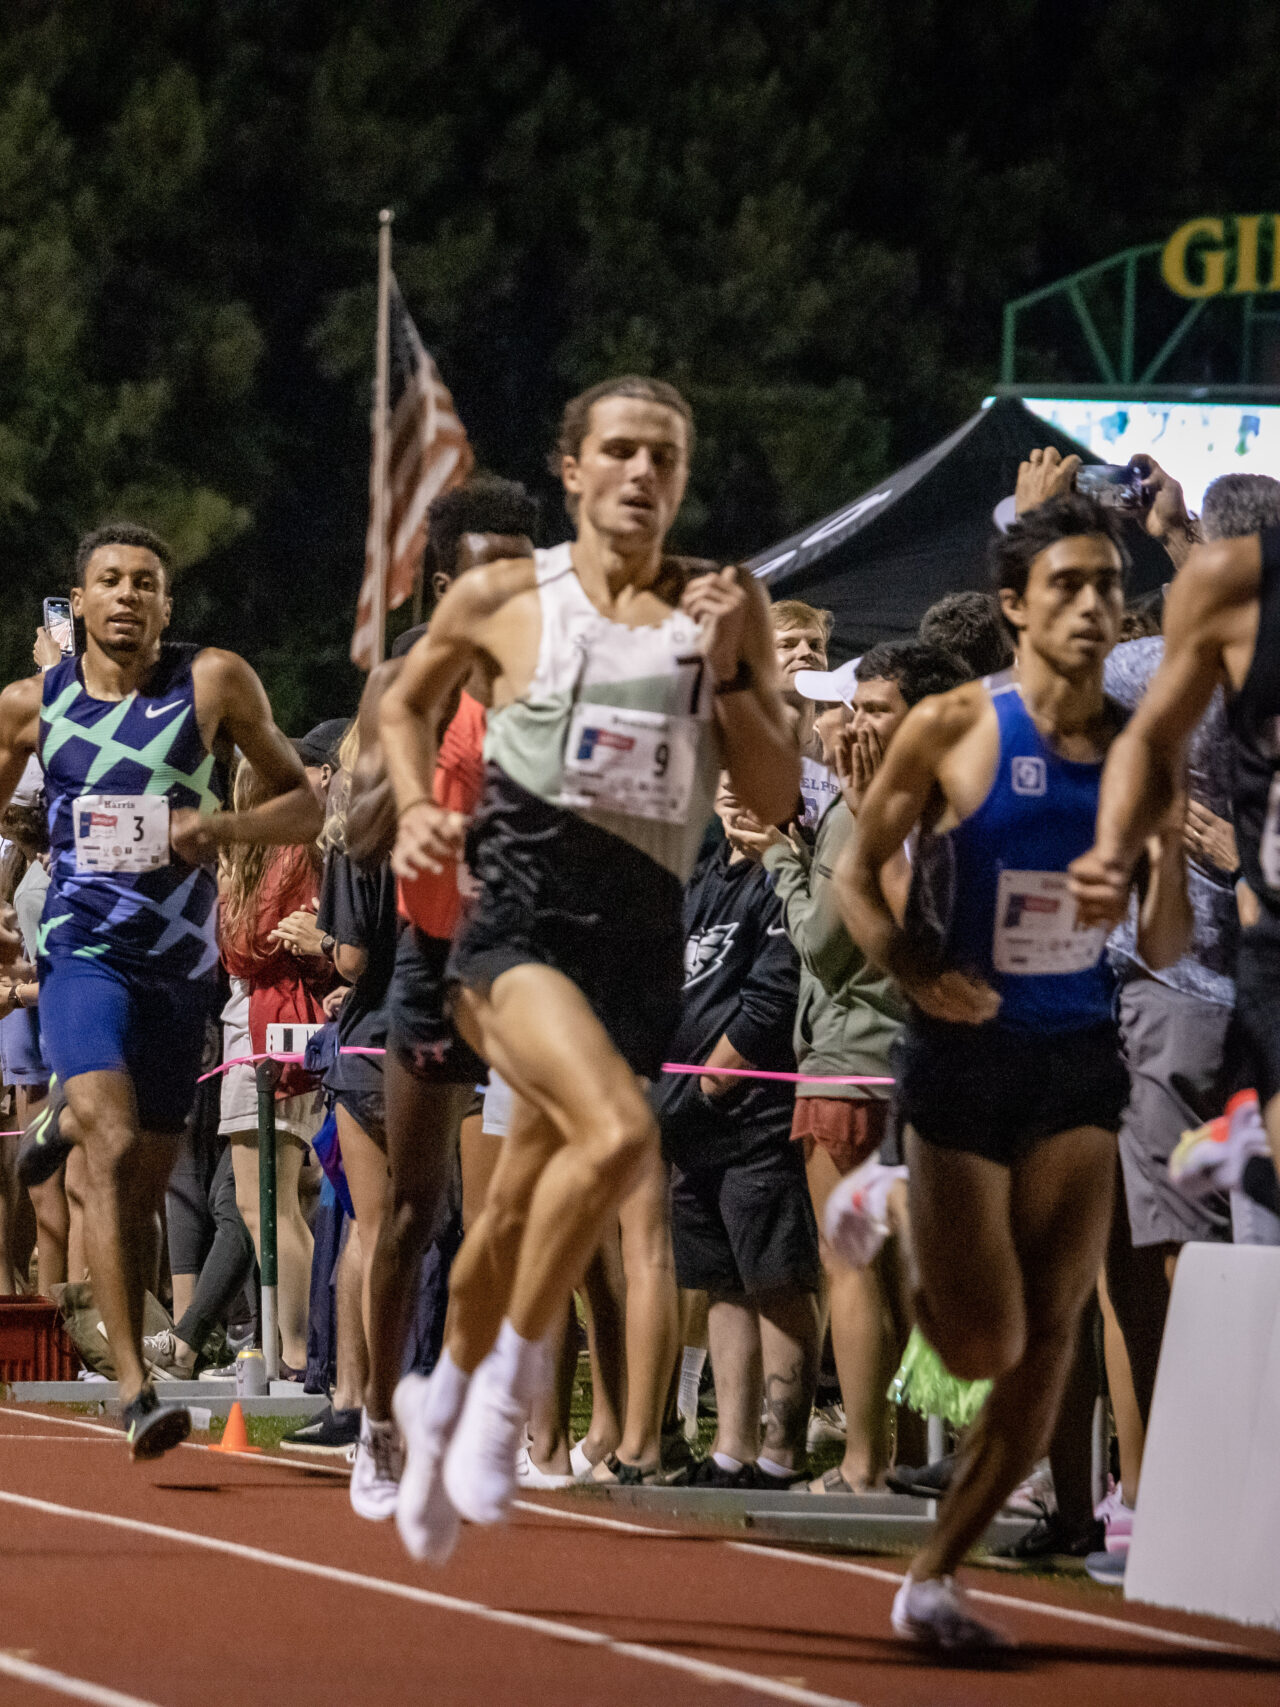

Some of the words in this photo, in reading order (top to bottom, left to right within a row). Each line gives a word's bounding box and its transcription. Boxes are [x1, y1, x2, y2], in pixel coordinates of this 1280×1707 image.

[1162, 214, 1280, 298] GI
[676, 655, 704, 715] 7
[653, 743, 669, 778] 9
[104, 800, 135, 809] Harris
[133, 816, 144, 842] 3
